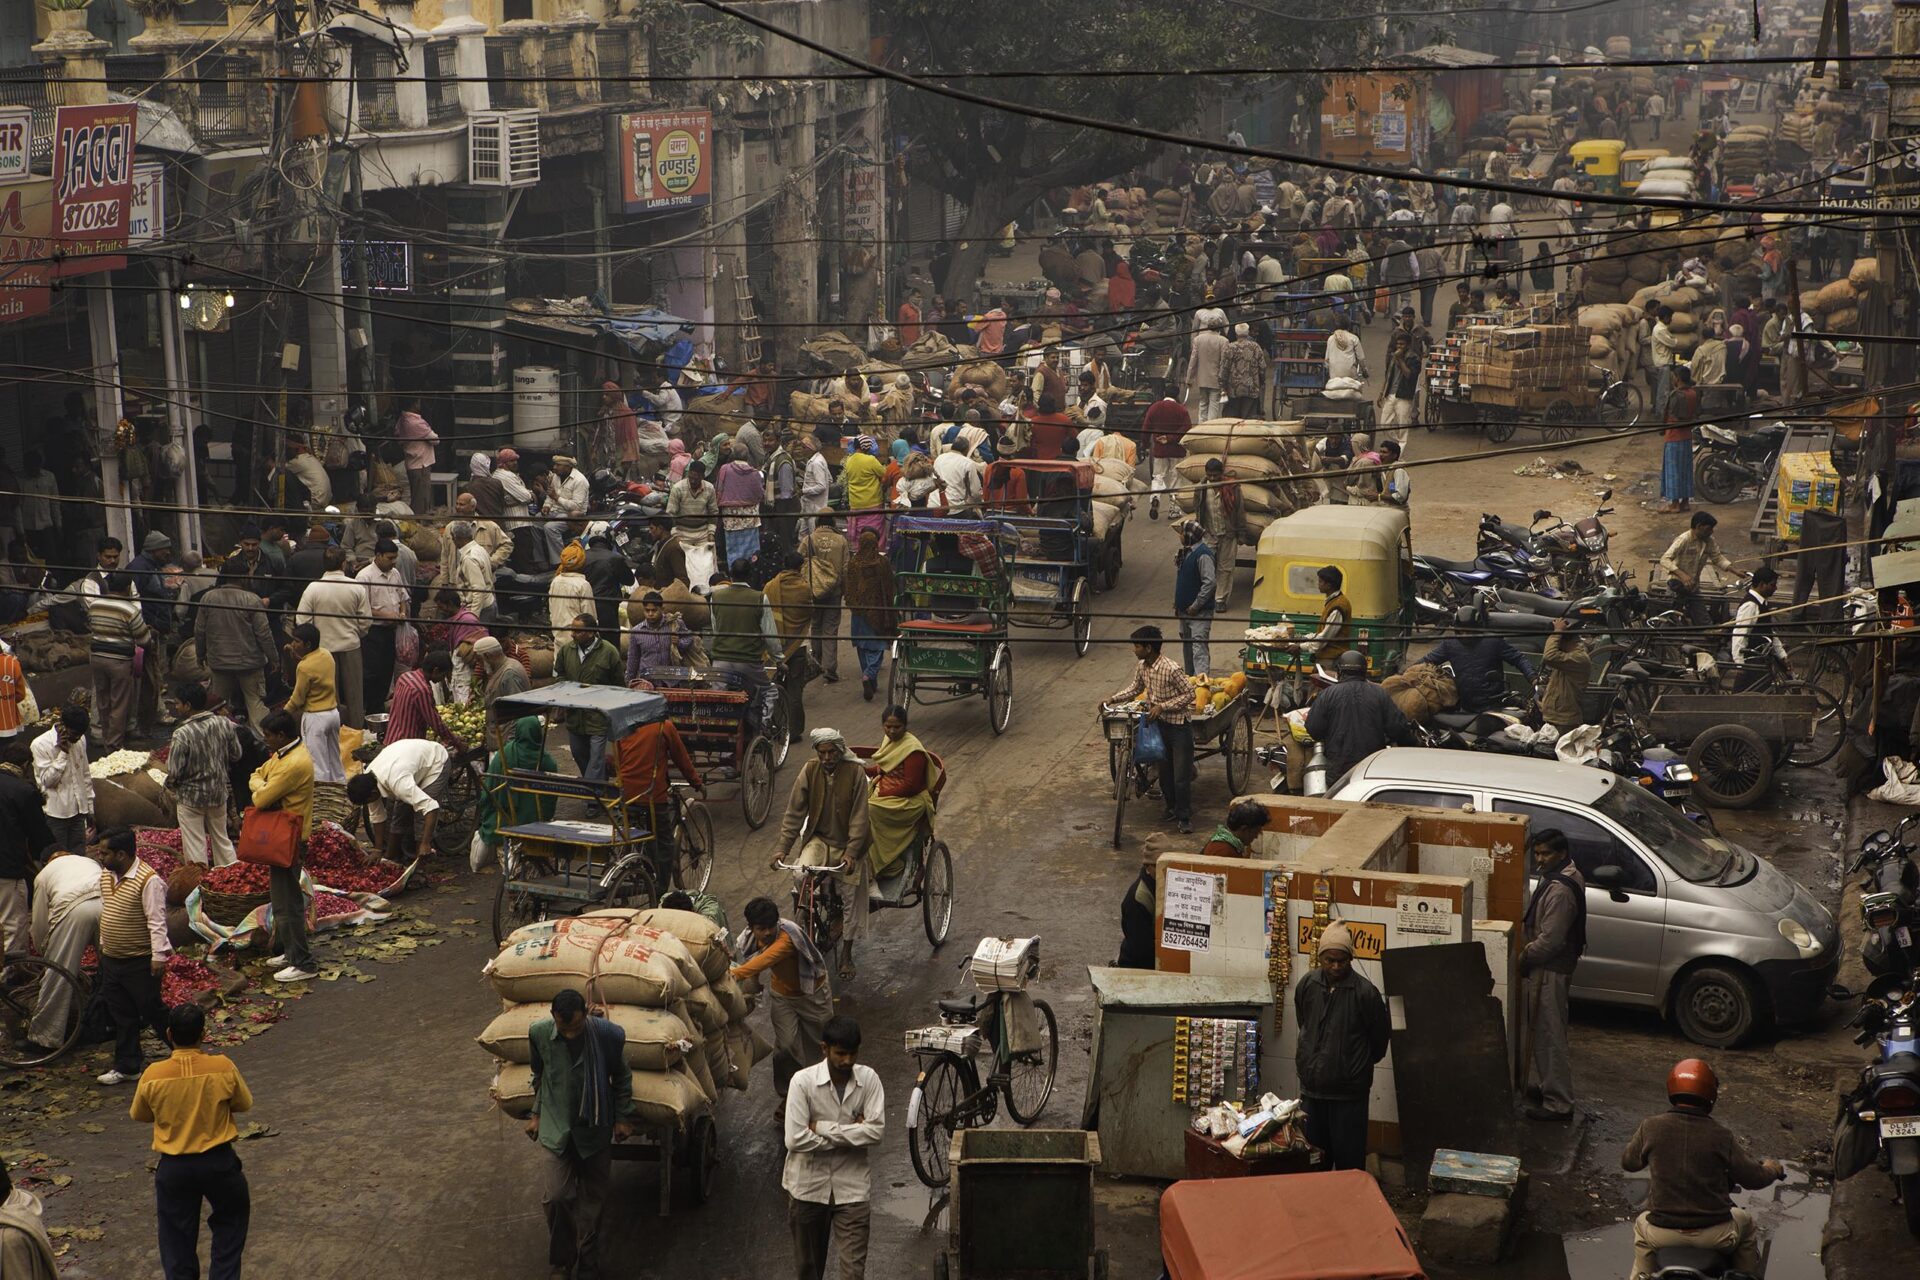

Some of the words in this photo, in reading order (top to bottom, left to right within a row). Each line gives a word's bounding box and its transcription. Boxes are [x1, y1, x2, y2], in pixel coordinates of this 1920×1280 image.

[59, 123, 131, 206] JAGGI
[647, 198, 670, 208] LAMBA
[671, 195, 692, 204] STORE
[1820, 195, 1873, 209] KAILAS
[64, 201, 119, 231] STORE
[95, 240, 123, 252] Fruits
[1164, 933, 1208, 949] 8527264454
[1354, 929, 1381, 954] City
